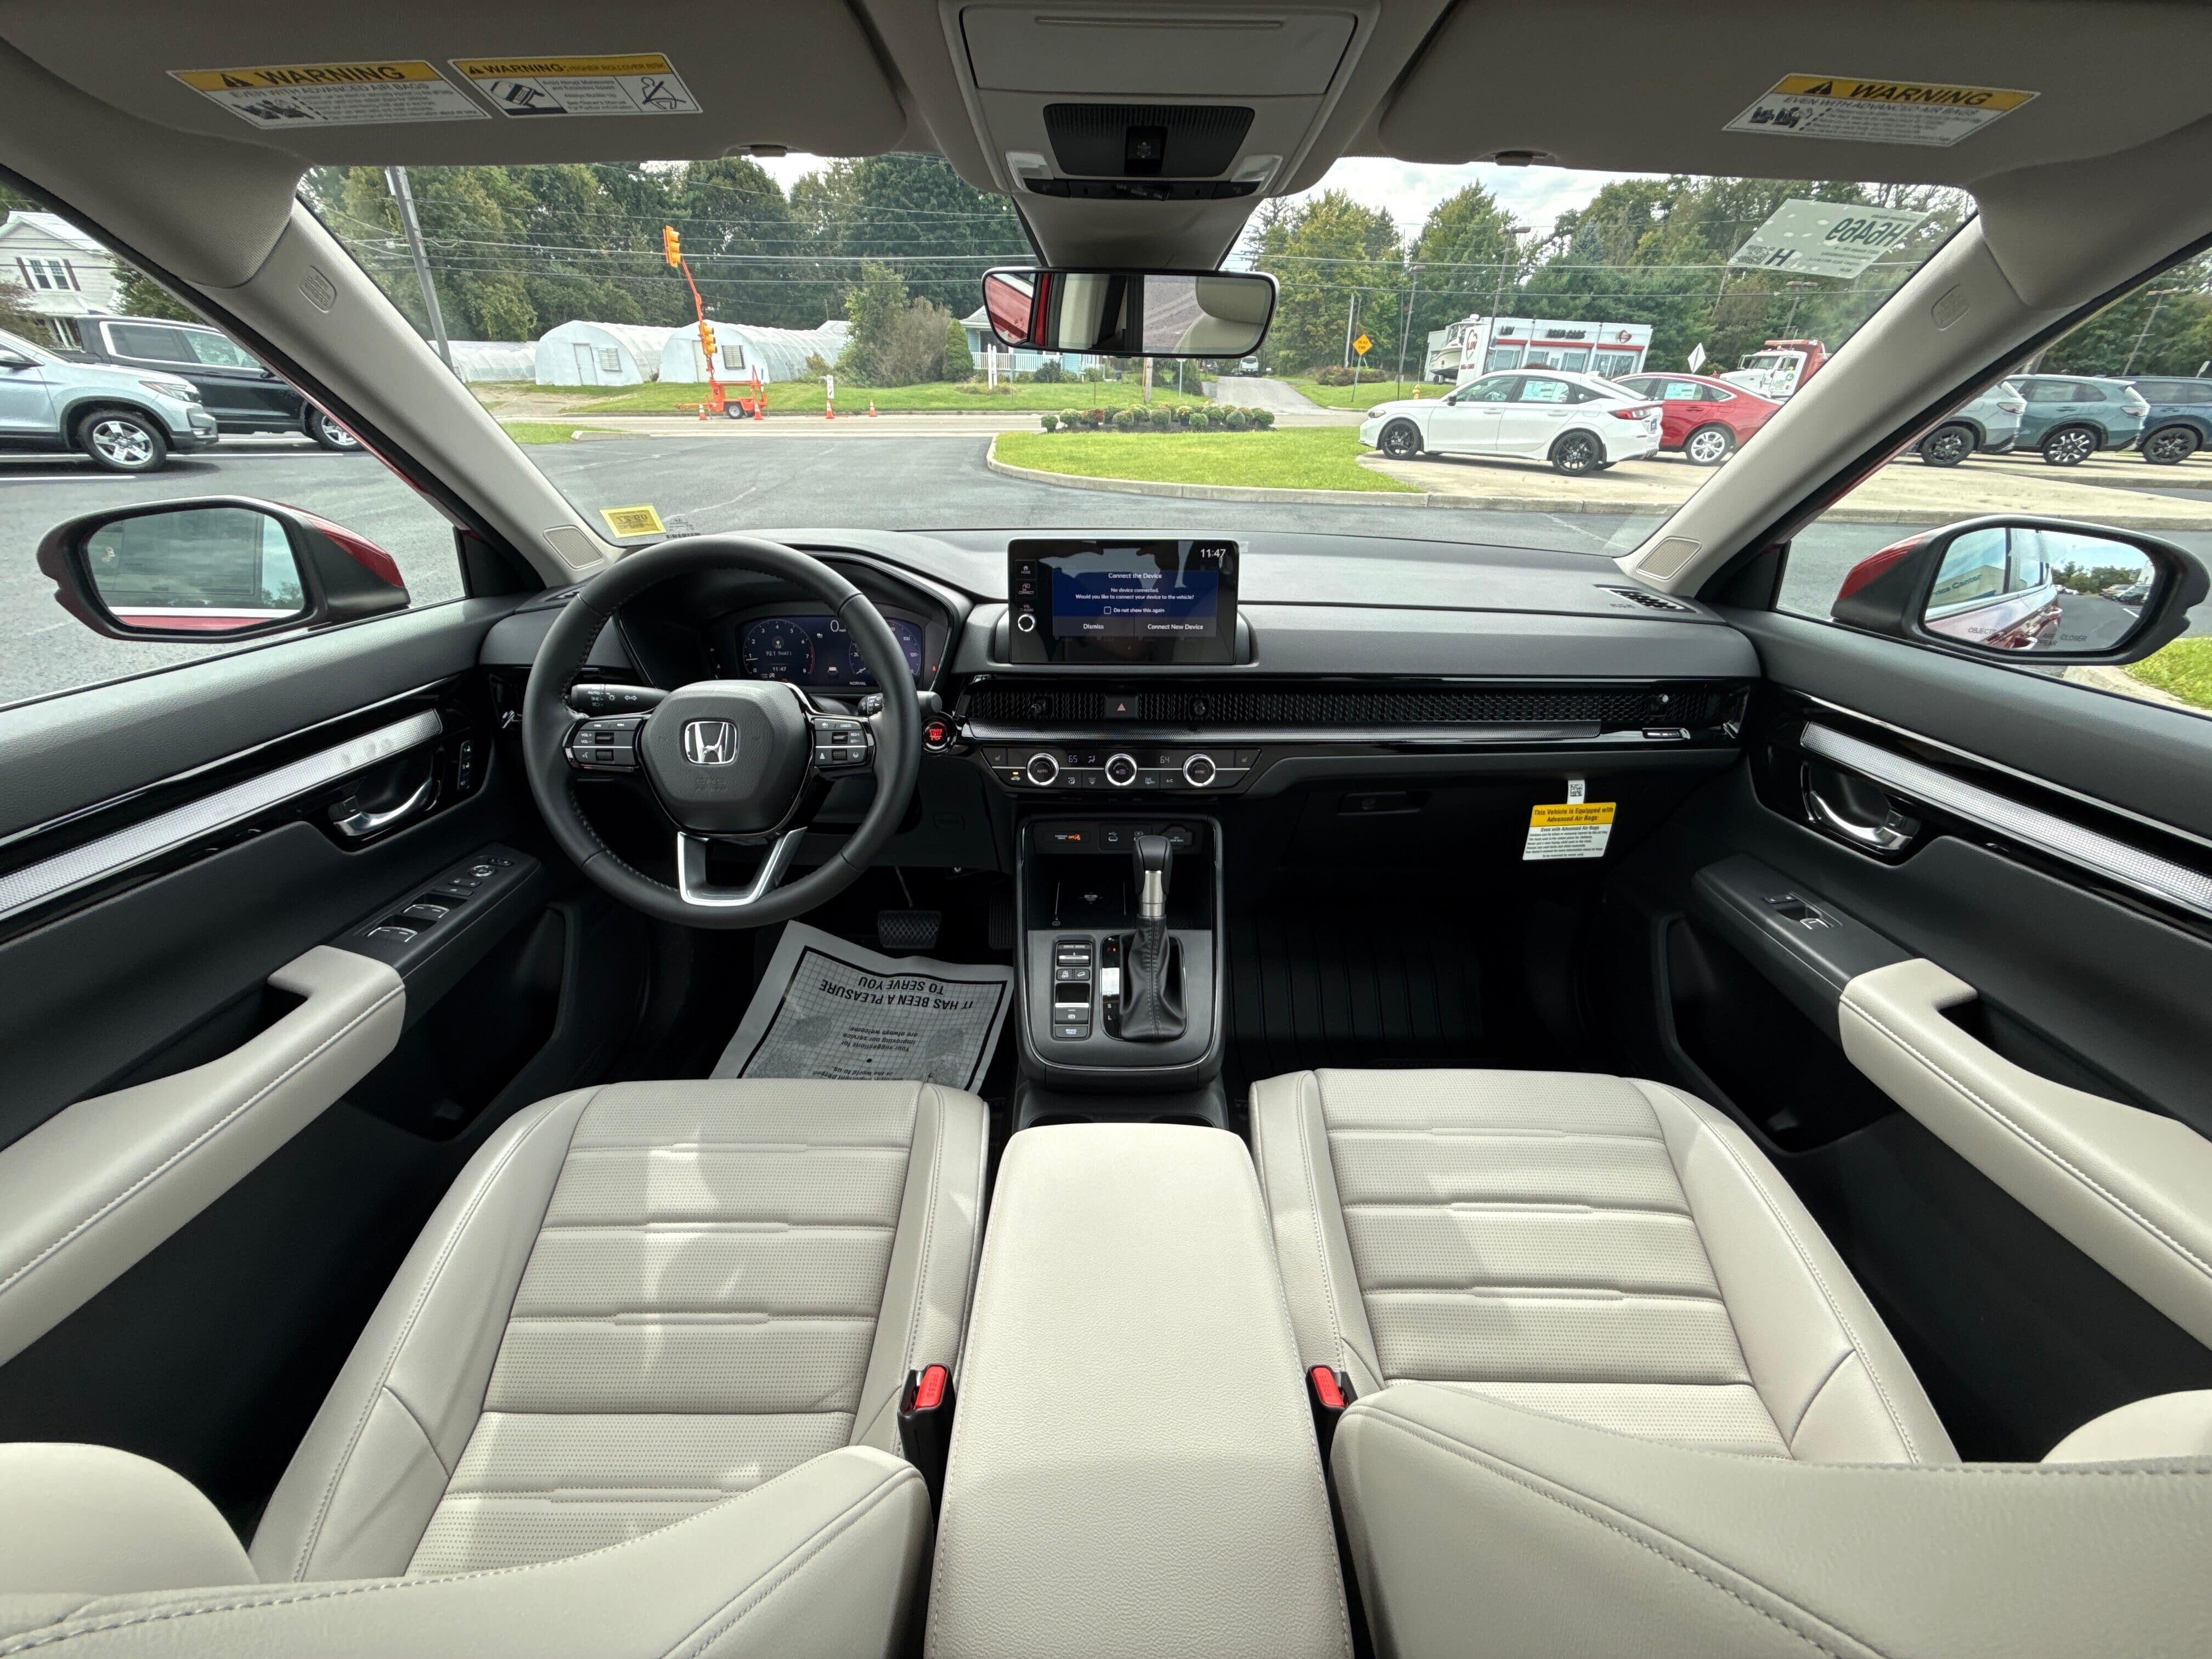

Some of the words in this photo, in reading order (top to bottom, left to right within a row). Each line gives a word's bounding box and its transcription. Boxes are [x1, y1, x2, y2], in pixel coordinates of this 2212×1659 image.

[253, 65, 405, 85] WARNING
[1849, 84, 1993, 105] WARNING
[1200, 549, 1226, 558] 11:47
[830, 619, 839, 632] 0
[858, 976, 884, 991] YOU
[885, 979, 926, 991] SERVE
[929, 983, 944, 995] TO
[819, 979, 884, 1005] PLEASURE
[888, 994, 896, 1005] A
[898, 994, 930, 1008] BEEN
[933, 998, 959, 1010] HAS
[961, 1000, 974, 1009] IT
[843, 1032, 868, 1041] service
[882, 1037, 916, 1045] improving
[812, 1070, 836, 1080] person
